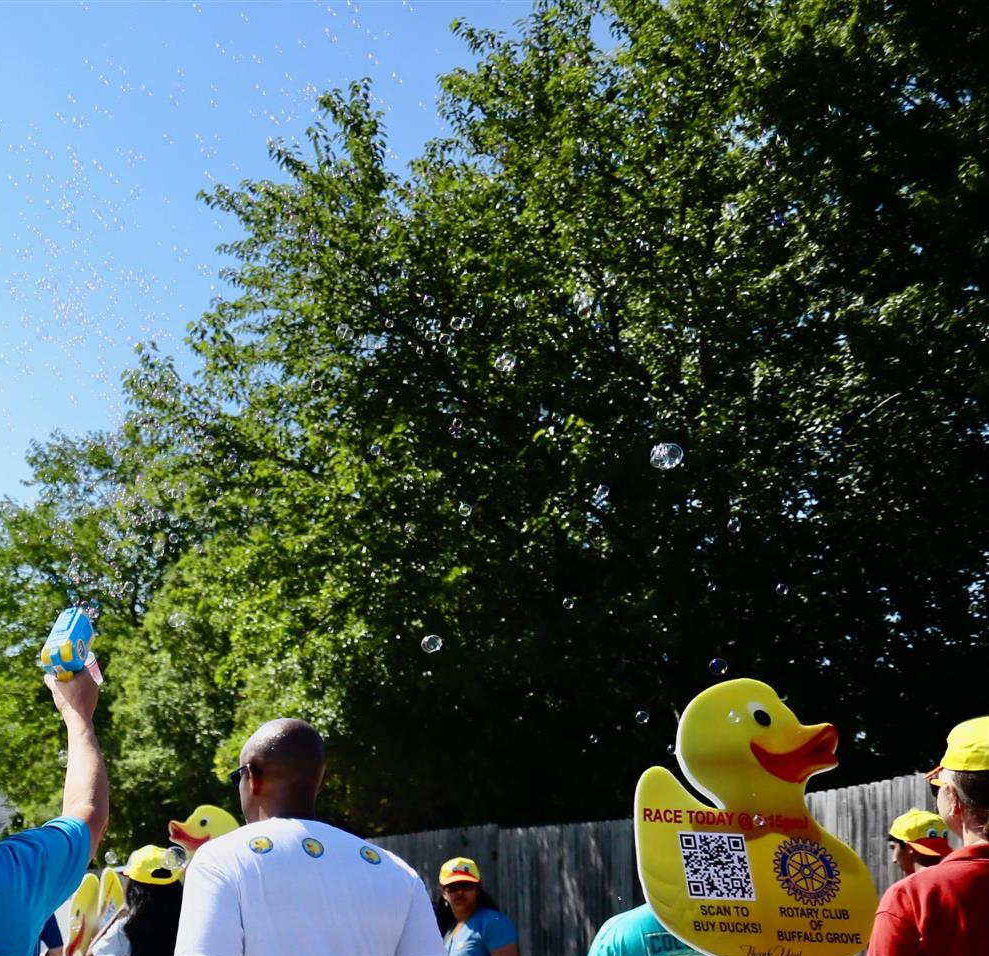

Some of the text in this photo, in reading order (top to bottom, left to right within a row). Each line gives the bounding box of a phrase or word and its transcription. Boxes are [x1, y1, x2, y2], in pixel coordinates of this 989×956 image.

[643, 808, 682, 823] RACE
[686, 810, 735, 826] TODAY
[700, 905, 749, 917] SCAN TO
[779, 907, 850, 920] ROTARY CLUB
[693, 920, 762, 934] BUY DUCKS!
[810, 920, 824, 931] OF
[777, 931, 862, 944] BUFFALO GROVE
